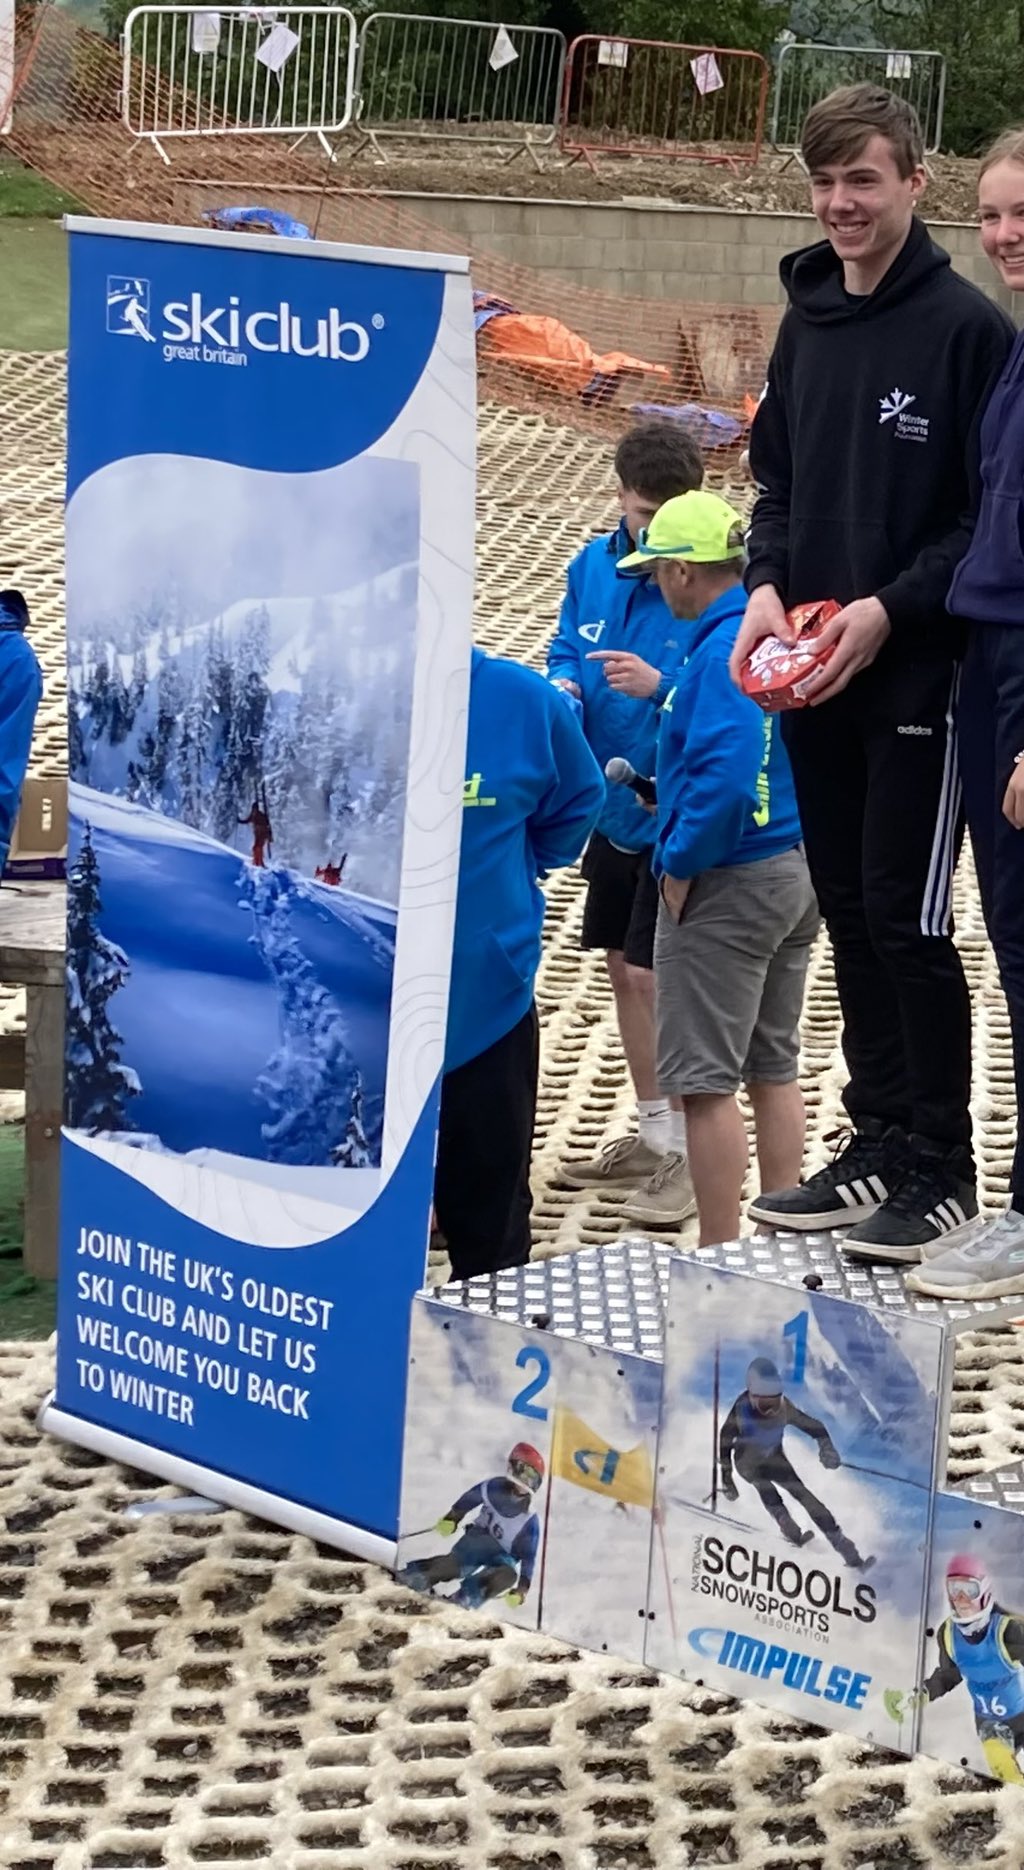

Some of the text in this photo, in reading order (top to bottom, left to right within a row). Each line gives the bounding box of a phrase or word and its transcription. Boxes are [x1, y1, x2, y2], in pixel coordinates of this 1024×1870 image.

[163, 344, 247, 366] great britain
[897, 725, 932, 736] adidas
[77, 1227, 334, 1330] JOIN THE UK'S OLDEST
[77, 1271, 316, 1373] SKI CLUB AND LET US
[783, 1311, 810, 1384] 1
[76, 1314, 310, 1420] WELCOME YOU BACK
[76, 1358, 194, 1426] TO WINTER
[511, 1345, 551, 1421] 2
[700, 1575, 830, 1633] SNOWSPORTS
[702, 1536, 877, 1624] SCHOOLS
[753, 1613, 830, 1645] ASSOCIATION
[717, 1630, 872, 1711] IMPULSE
[975, 1693, 1008, 1717] 16
